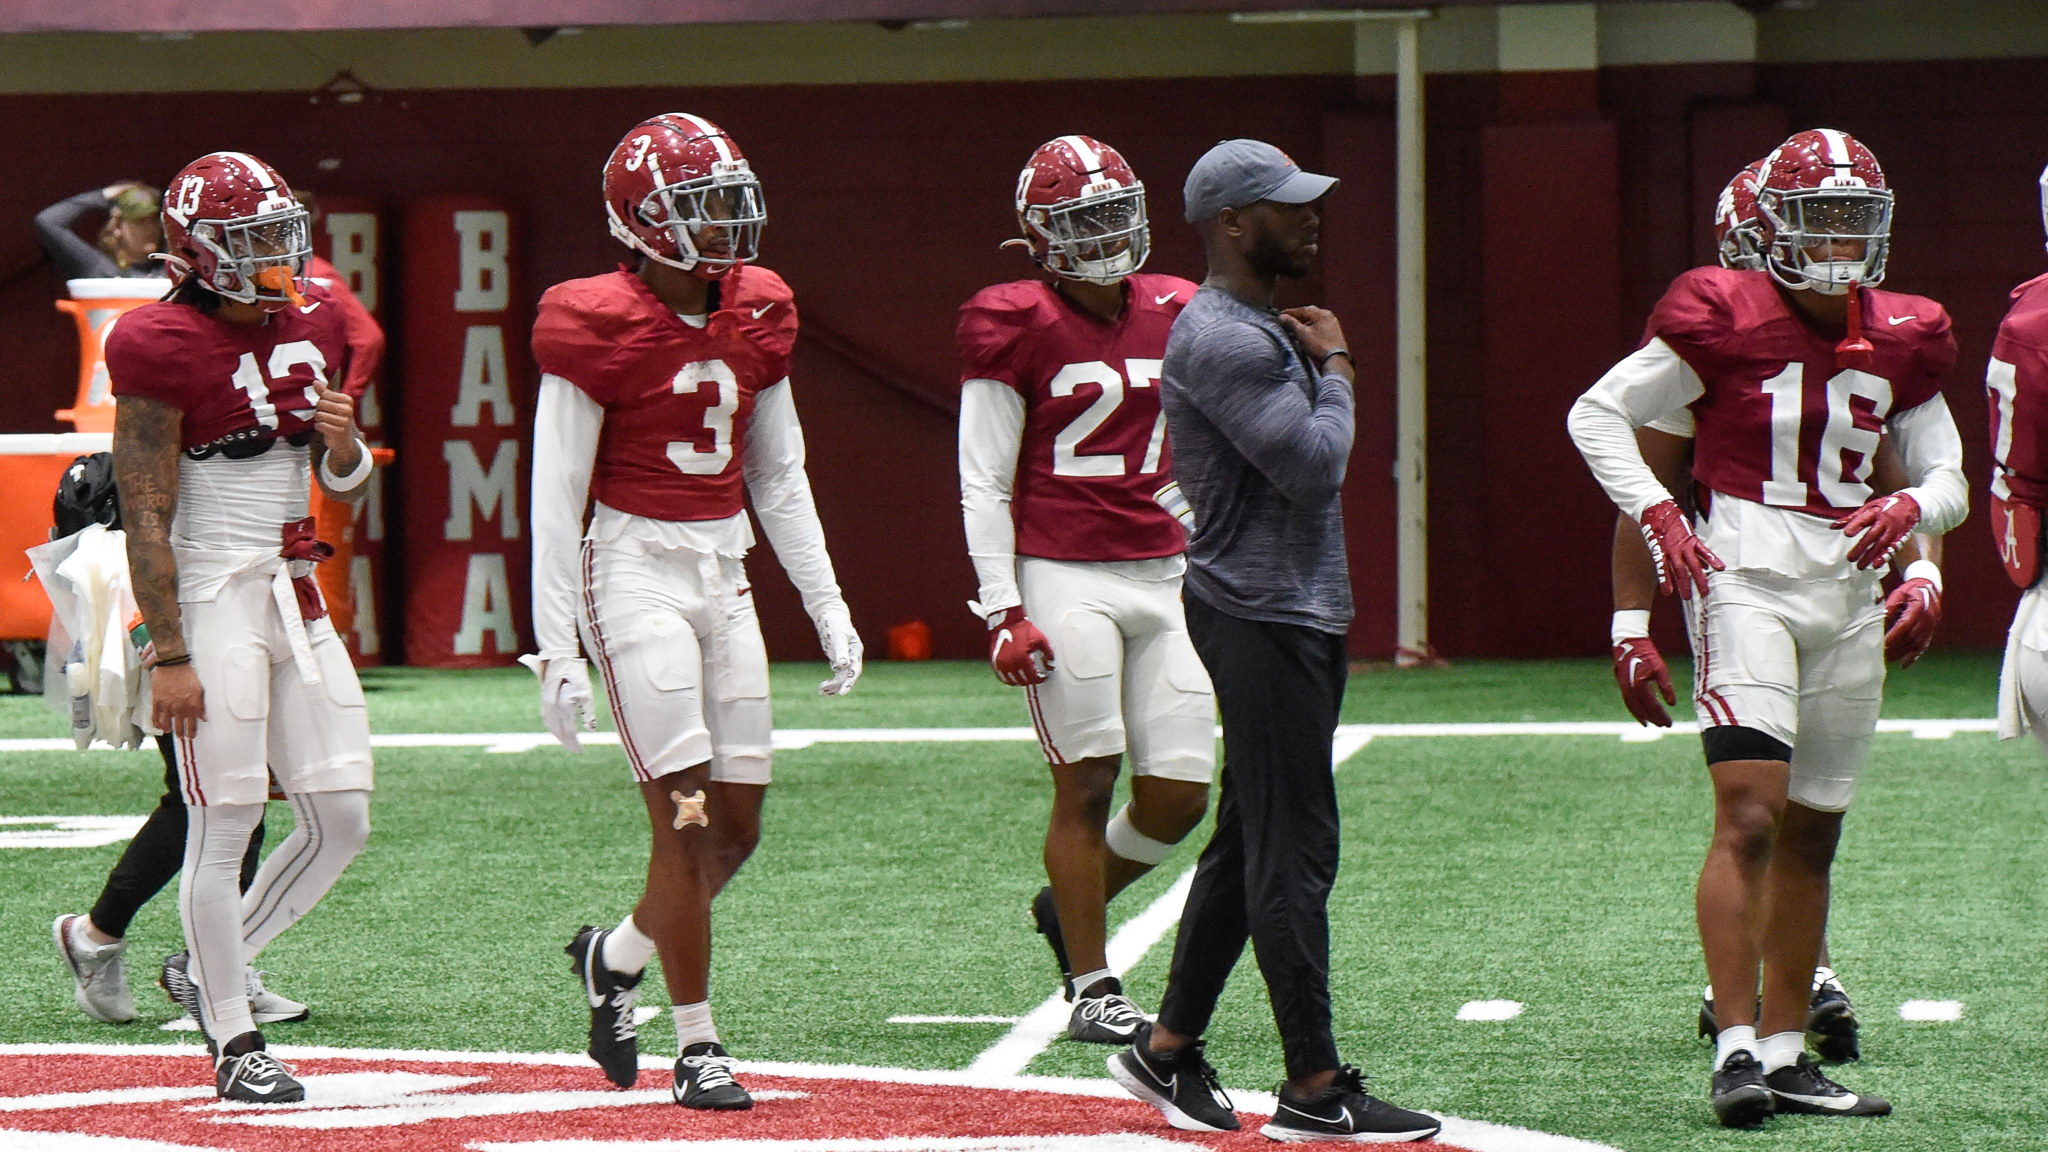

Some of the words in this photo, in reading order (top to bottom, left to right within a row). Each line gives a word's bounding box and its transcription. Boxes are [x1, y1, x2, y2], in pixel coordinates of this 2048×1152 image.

[177, 176, 205, 216] 13
[626, 134, 652, 172] 3
[231, 340, 328, 430] 13
[443, 211, 519, 655] BAMA
[666, 359, 739, 475] 3
[1050, 358, 1168, 477] 27
[1762, 362, 1893, 508] 16
